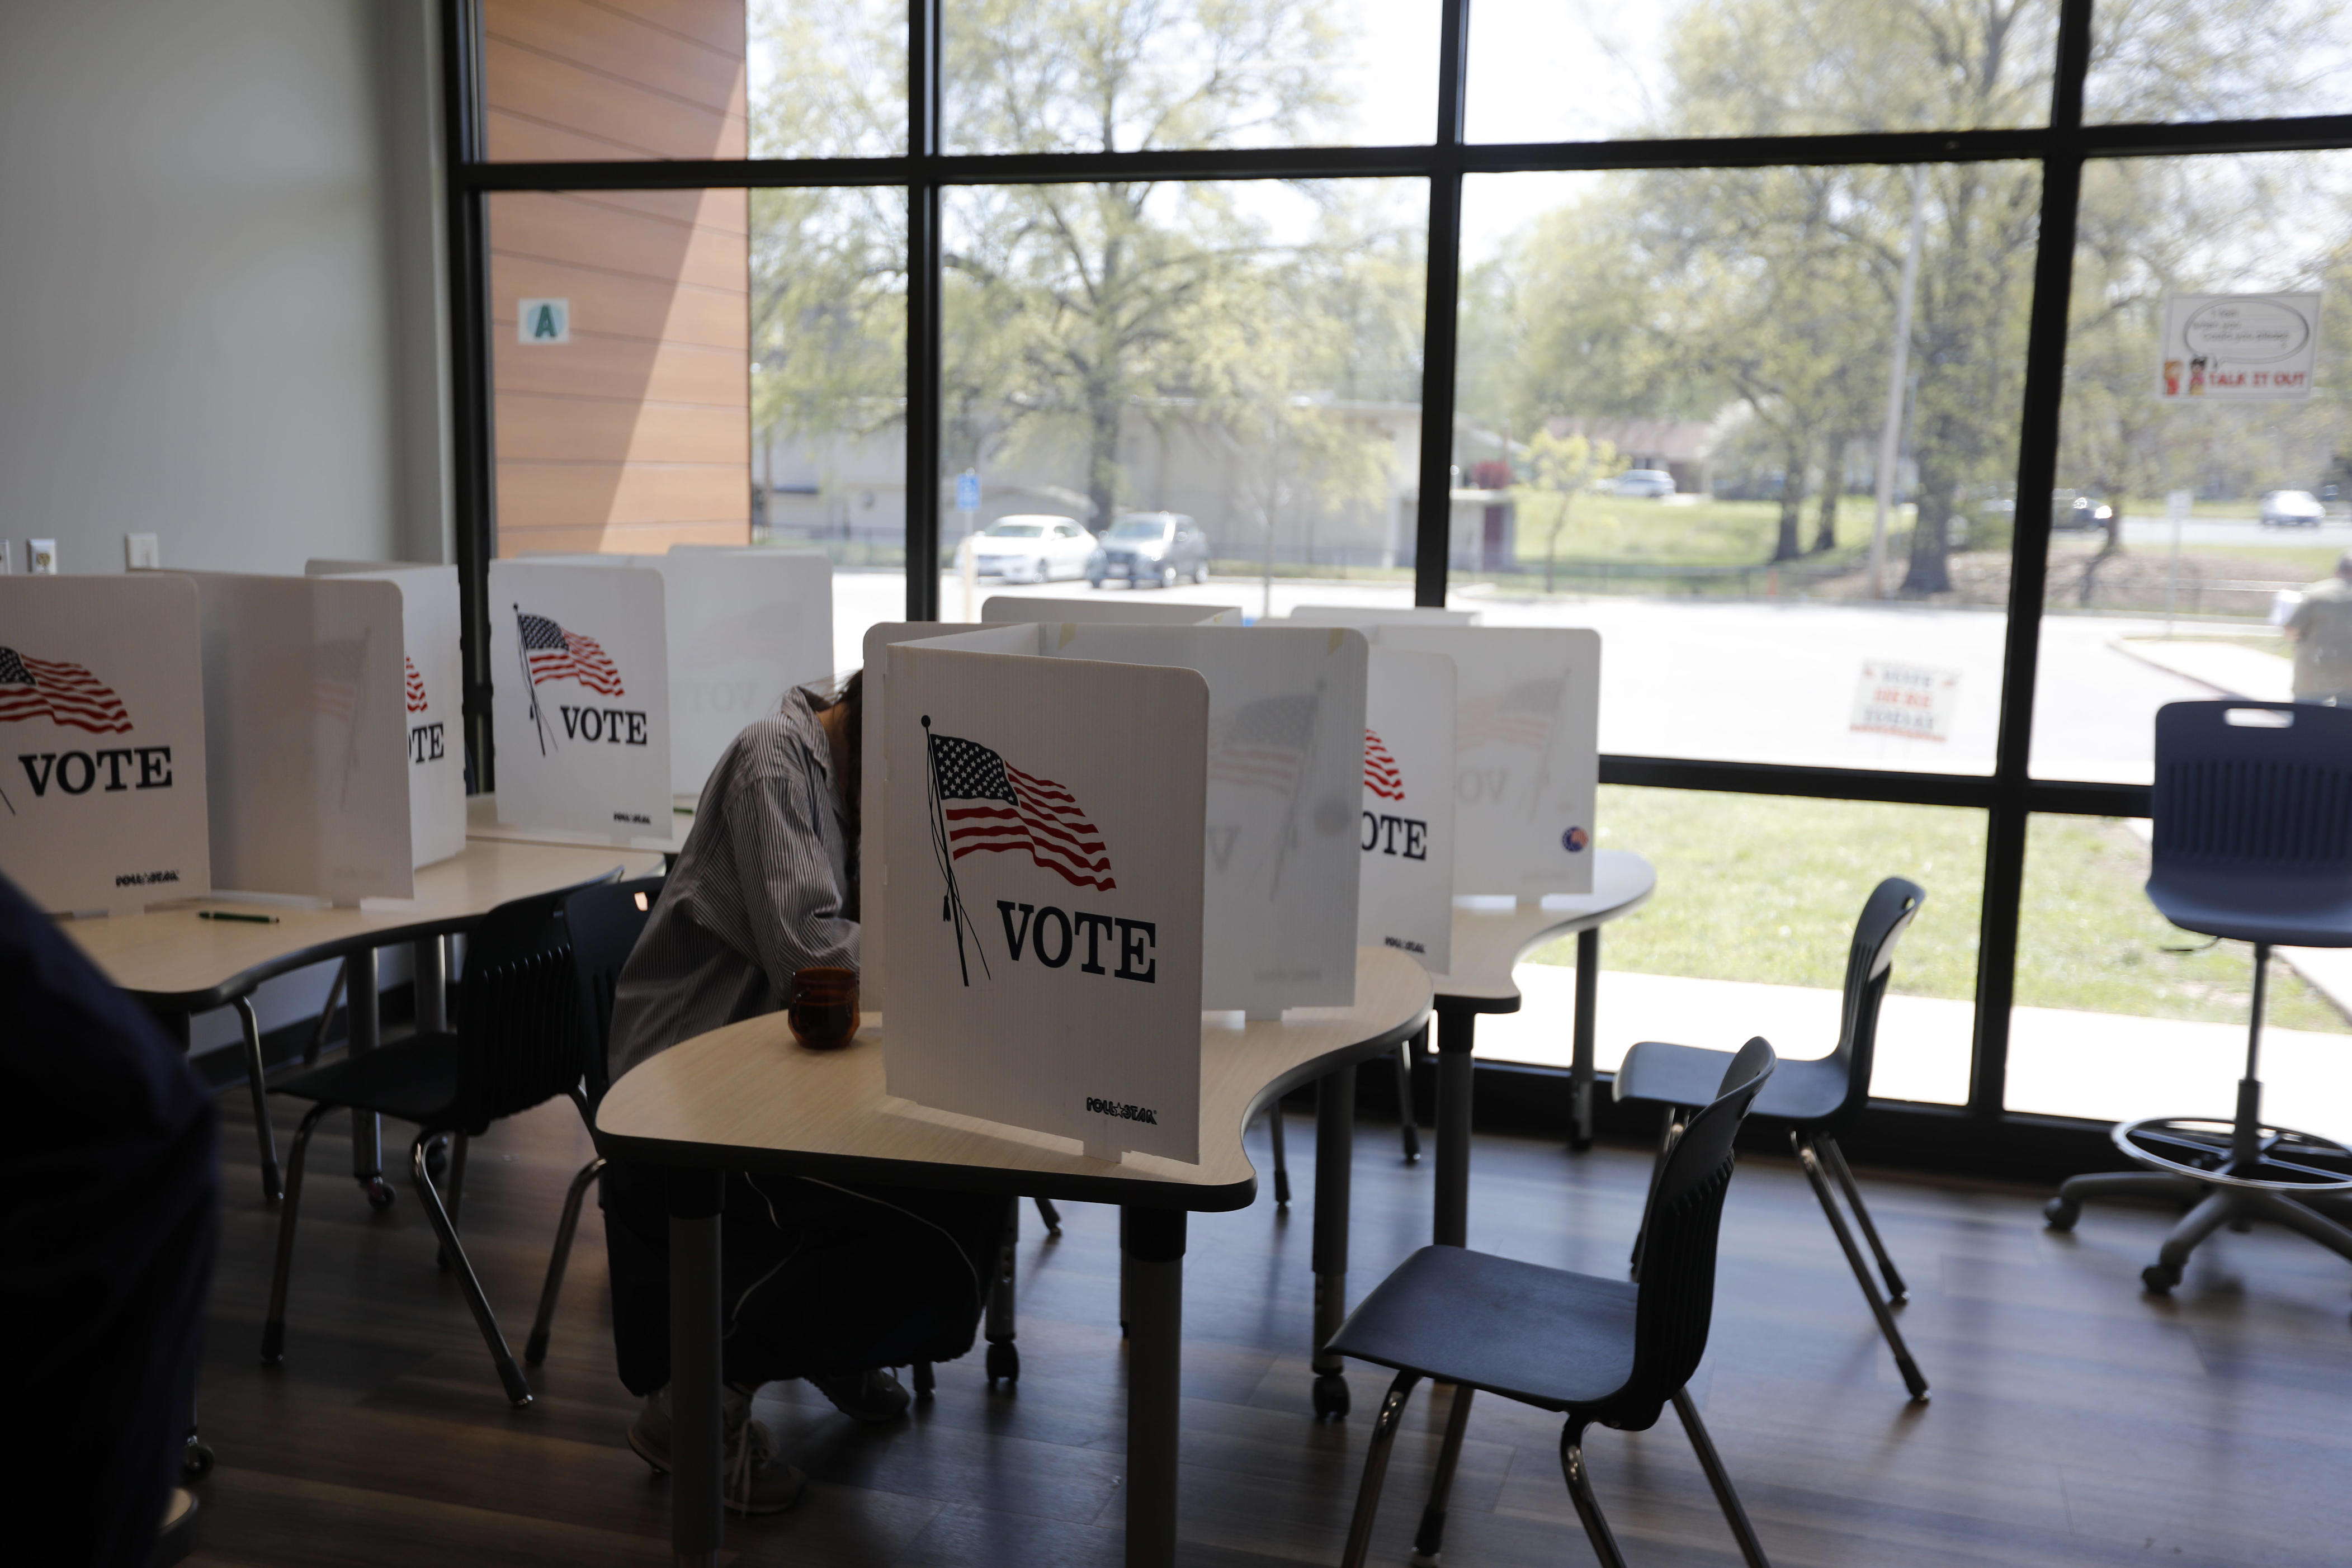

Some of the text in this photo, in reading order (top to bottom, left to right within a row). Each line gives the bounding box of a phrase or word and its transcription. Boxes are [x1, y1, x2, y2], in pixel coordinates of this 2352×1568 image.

[535, 304, 558, 338] A
[2208, 371, 2306, 386] TALK IT OUT
[408, 722, 444, 764] TE
[560, 705, 648, 745] VOTE
[18, 745, 172, 797] VOTE
[1362, 811, 1427, 860] OTE
[996, 900, 1156, 984] VOTE
